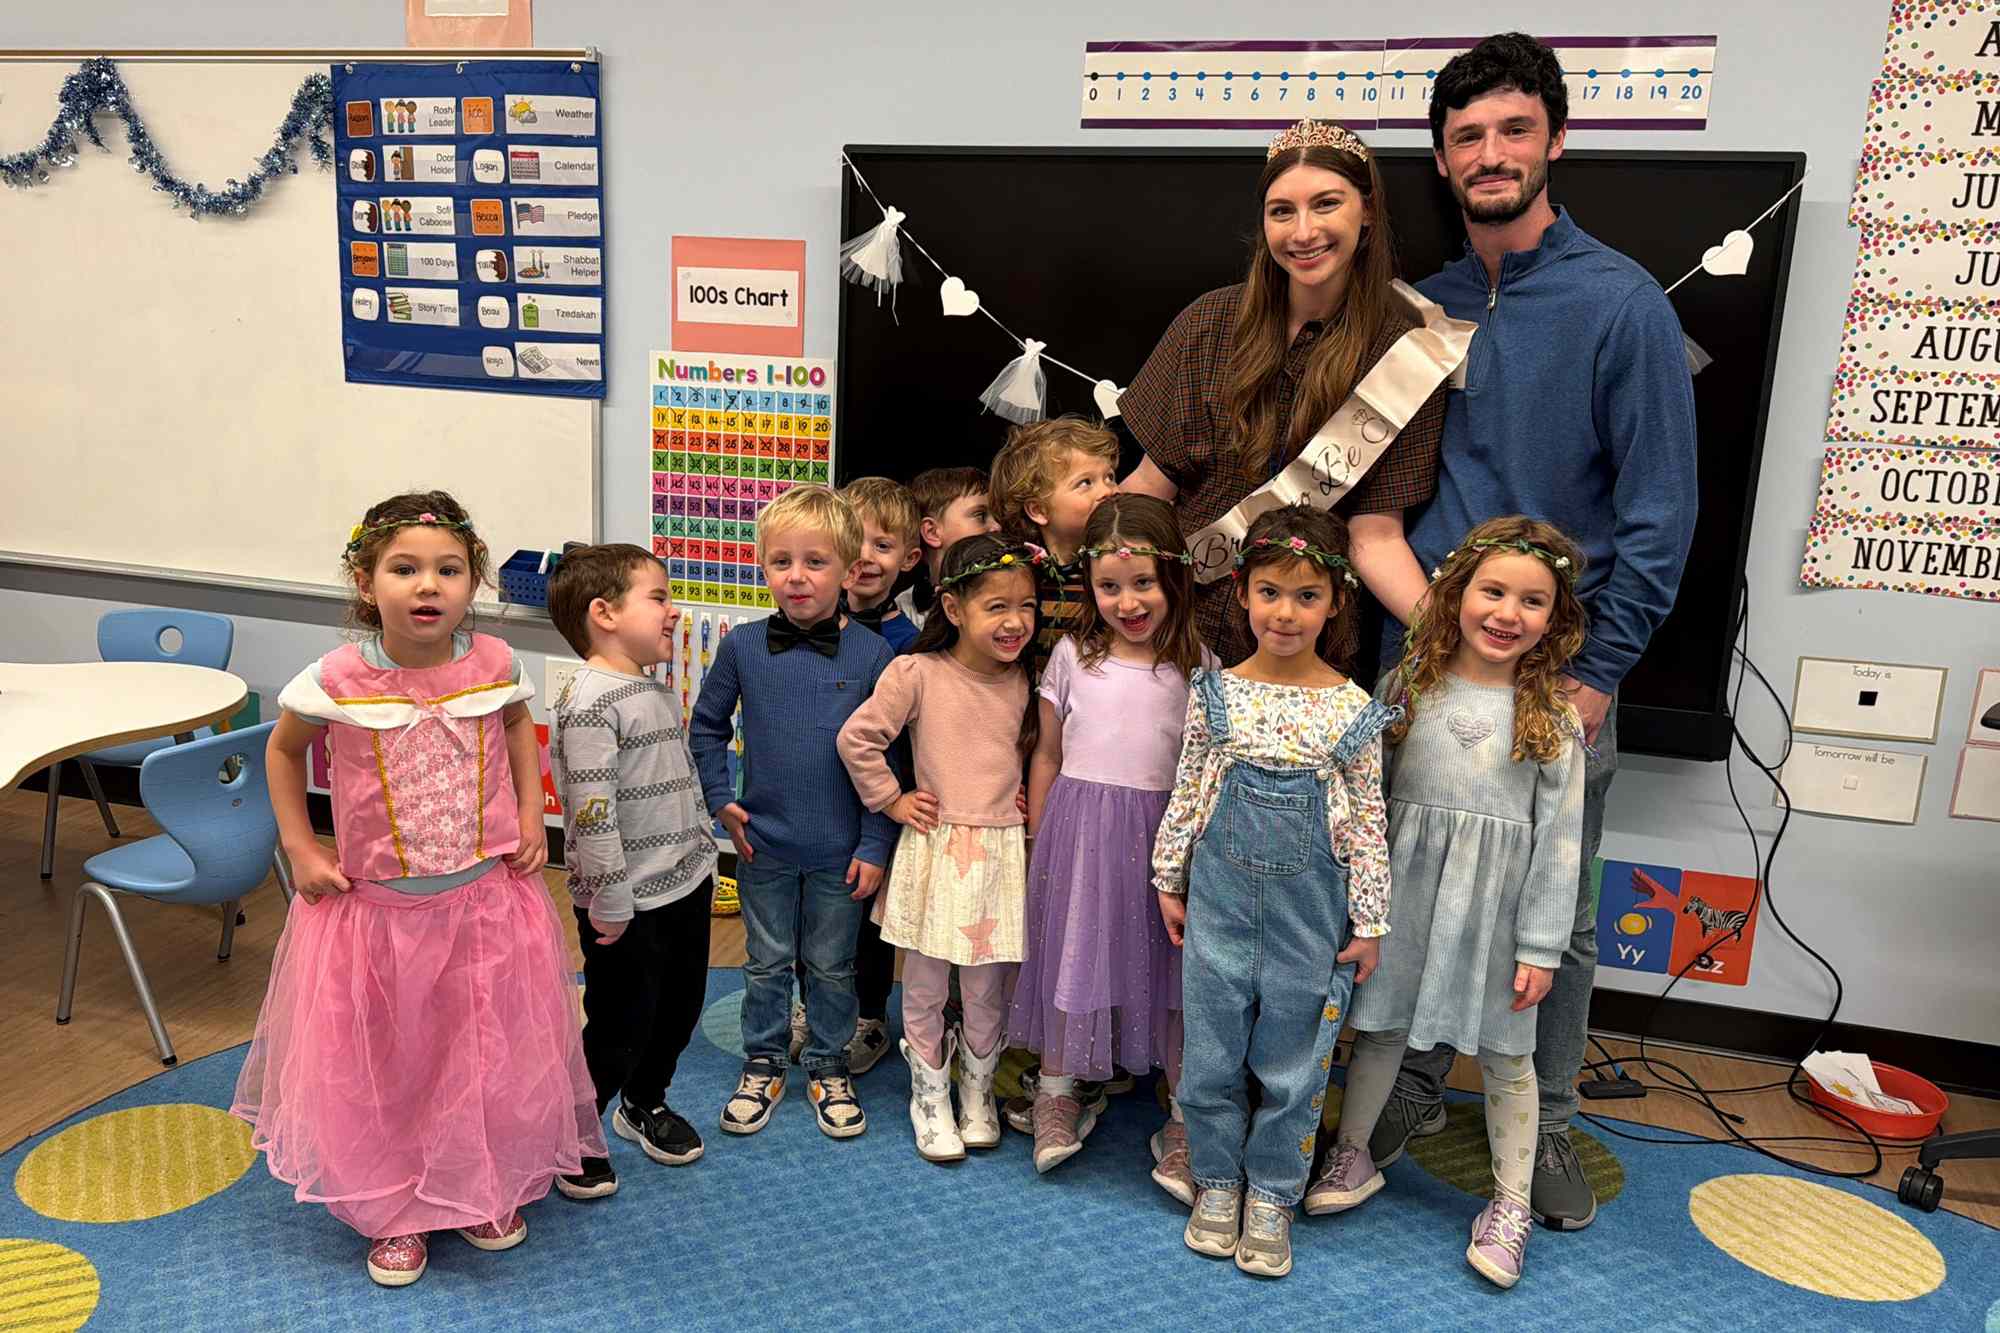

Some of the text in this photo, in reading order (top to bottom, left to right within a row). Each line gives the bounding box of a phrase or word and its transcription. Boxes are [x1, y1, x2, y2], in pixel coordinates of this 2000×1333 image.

[1089, 88, 1098, 101] 0
[1142, 88, 1150, 101] 2
[1169, 88, 1177, 101] 3
[1196, 88, 1204, 101] 4
[1223, 88, 1232, 101] 5
[1251, 88, 1260, 101] 6
[1279, 88, 1288, 101] 7
[1307, 88, 1316, 101] 8
[1336, 88, 1344, 101] 9
[1362, 88, 1376, 101] 10
[1391, 86, 1404, 100] 11
[1583, 86, 1600, 100] 17
[1616, 86, 1633, 100] 18
[1650, 86, 1667, 99] 19
[1681, 85, 1702, 100] 20
[556, 108, 593, 118] Weather
[436, 153, 454, 162] Door
[430, 166, 455, 174] Holder
[554, 161, 595, 171] Calendar
[420, 217, 452, 226] Caboose
[567, 211, 598, 222] Pledge
[420, 257, 455, 268] 100 Days
[563, 255, 599, 264] Shabbat
[571, 267, 599, 277] Helper
[690, 285, 788, 306] 100s Chart
[418, 303, 457, 314] Story Time
[556, 309, 596, 320] Tzedakah
[1911, 326, 2000, 362] AUG
[576, 357, 599, 366] News
[658, 358, 826, 387] Numbers 1-100
[676, 392, 681, 401] 2
[711, 394, 717, 403] 4
[746, 396, 752, 405] 6
[765, 397, 770, 406] 7
[783, 398, 788, 407] 8
[801, 399, 806, 408] 9
[817, 400, 827, 409] 10
[658, 413, 827, 432] 11 12 13 14 15 16 17 18 19 20
[672, 436, 683, 445] 22
[690, 437, 701, 446] 23
[726, 439, 736, 448] 25
[743, 441, 754, 449] 26
[797, 444, 808, 453] 29
[672, 457, 683, 466] 32
[726, 461, 736, 470] 35
[743, 463, 754, 471] 36
[656, 478, 665, 487] 41
[690, 480, 701, 490] 43
[707, 482, 718, 490] 44
[742, 485, 753, 493] 46
[760, 486, 771, 495] 47
[724, 505, 735, 514] 55
[742, 507, 753, 516] 56
[724, 527, 735, 535] 65
[742, 528, 752, 536] 66
[689, 544, 700, 552] 73
[707, 546, 717, 554] 74
[724, 548, 735, 556] 75
[741, 549, 752, 558] 76
[672, 564, 682, 573] 82
[689, 566, 700, 575] 83
[724, 569, 735, 578] 85
[741, 570, 752, 579] 86
[672, 585, 683, 594] 92
[689, 587, 700, 596] 93
[724, 590, 735, 599] 95
[741, 592, 752, 600] 96
[759, 593, 769, 601] 97
[1852, 665, 1881, 680] Today
[1813, 746, 1895, 765] Tomorrow will be
[545, 792, 556, 806] h
[1617, 943, 1646, 965] Yy
